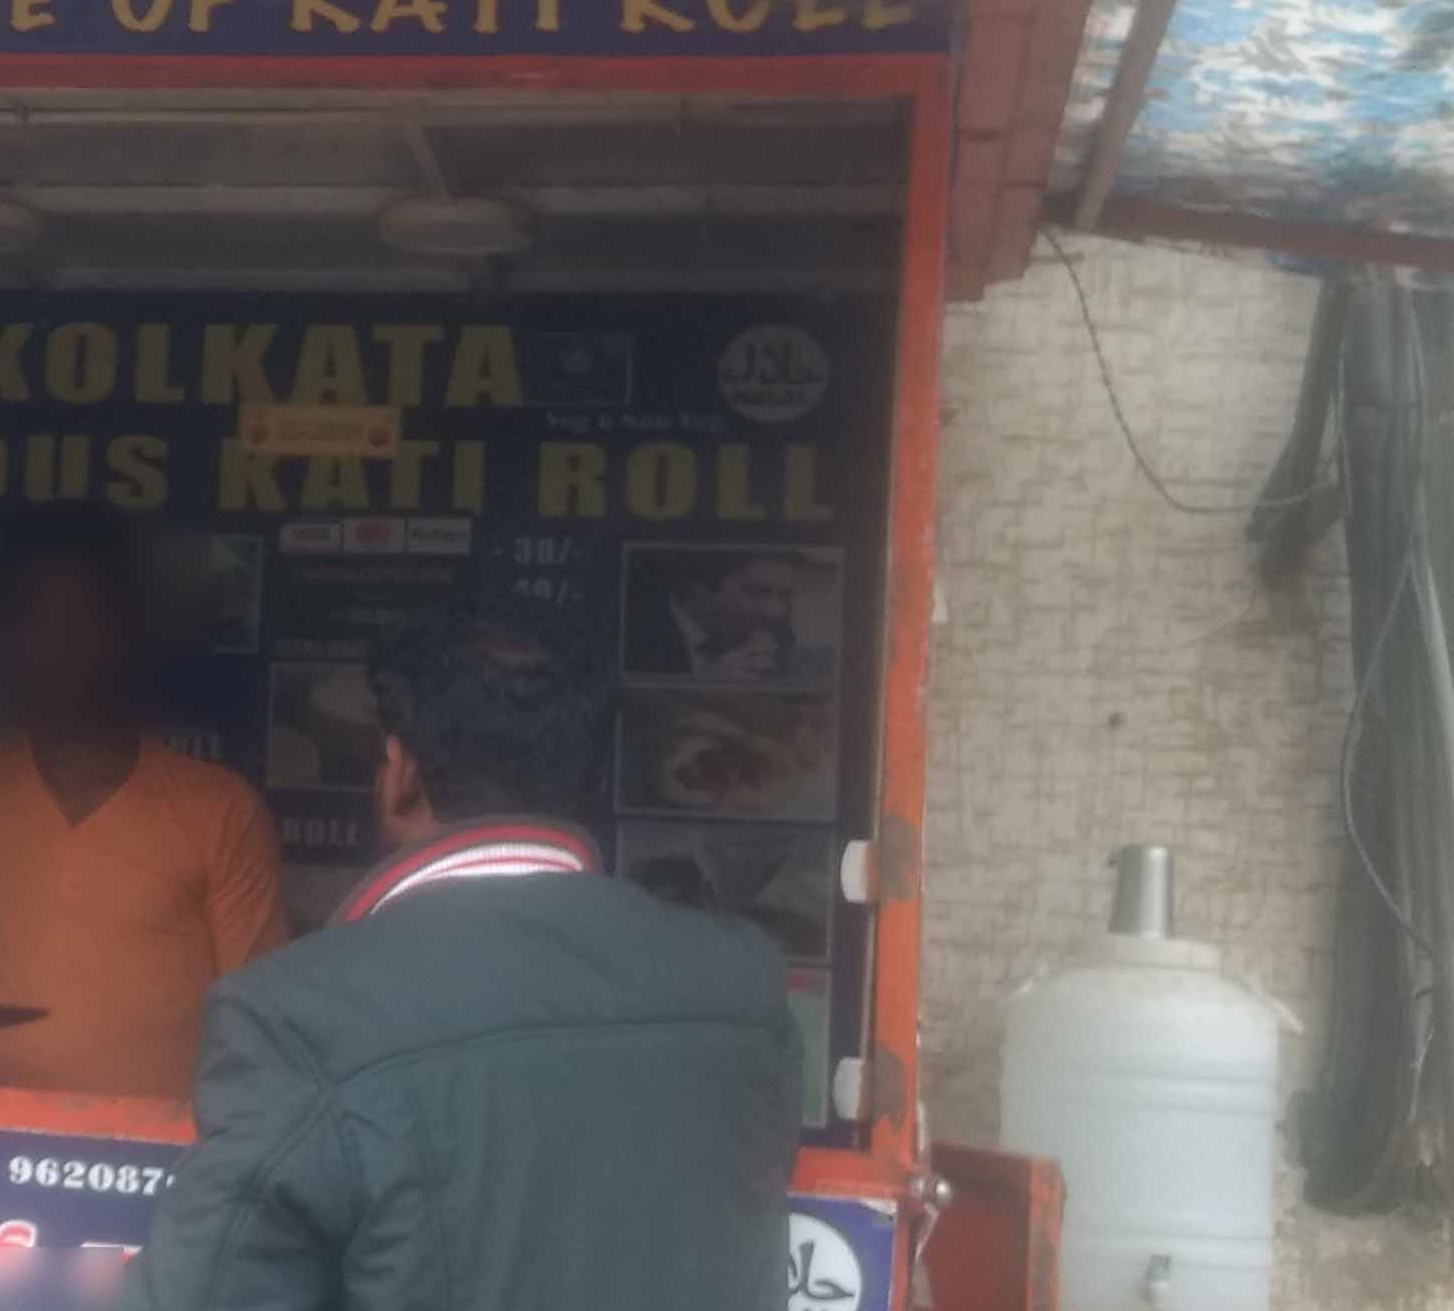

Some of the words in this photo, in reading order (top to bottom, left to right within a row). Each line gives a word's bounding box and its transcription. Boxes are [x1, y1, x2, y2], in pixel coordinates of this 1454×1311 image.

[217, 437, 487, 515] KATI
[537, 440, 836, 522] ROLL
[9, 1155, 175, 1197] 962087
